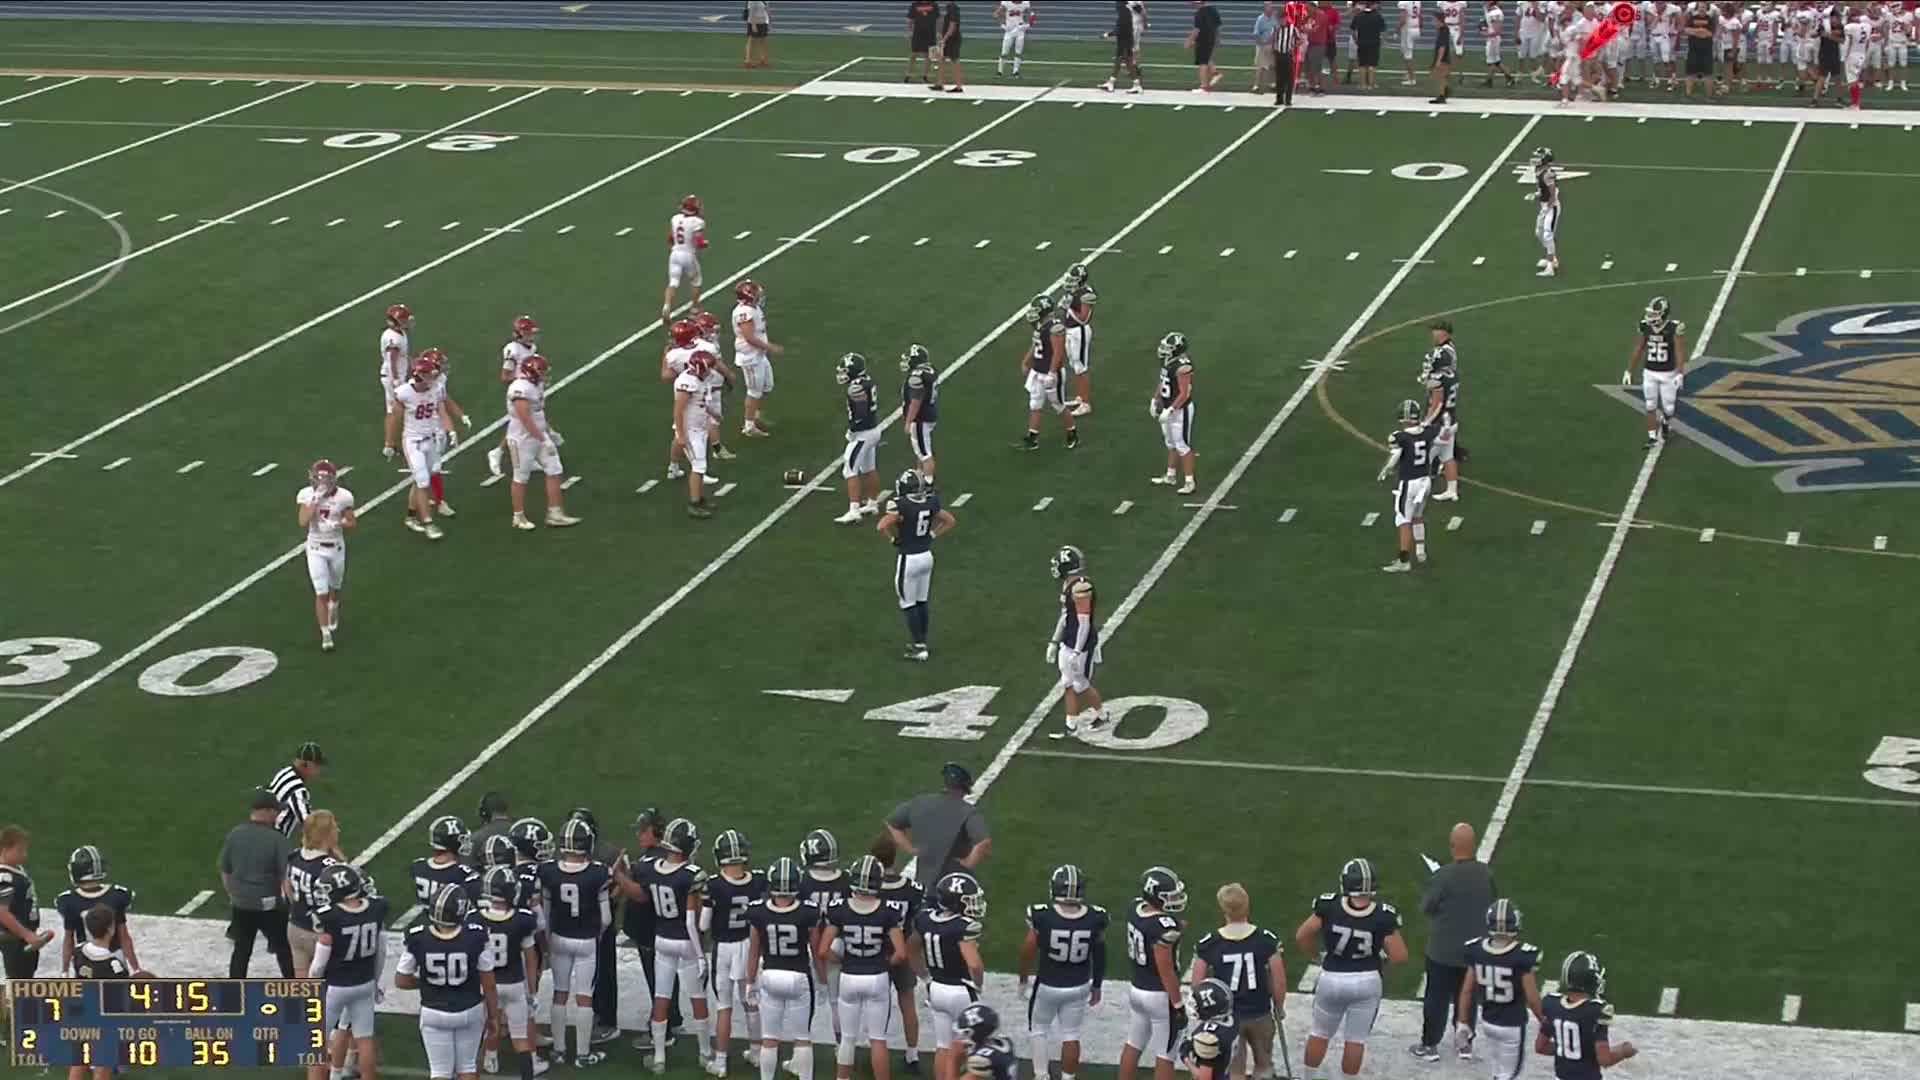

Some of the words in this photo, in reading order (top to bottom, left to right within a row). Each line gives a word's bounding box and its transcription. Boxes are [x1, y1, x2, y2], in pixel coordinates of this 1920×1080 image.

[1647, 341, 1669, 362] 26
[415, 402, 434, 420] 85
[1413, 440, 1427, 465] 5
[916, 509, 931, 537] 6
[1060, 549, 1072, 563] K
[444, 819, 461, 836] K
[524, 823, 541, 841] K
[807, 839, 820, 855] K
[333, 871, 351, 889] K
[948, 877, 965, 894] K
[560, 883, 579, 917] 9
[650, 883, 678, 918] 18
[341, 921, 377, 961] 70
[766, 923, 799, 956] 12
[843, 925, 883, 958] 25
[924, 931, 944, 969] 11
[1048, 929, 1091, 963] 56
[1332, 924, 1373, 960] 73
[425, 951, 468, 986] 50
[1222, 951, 1257, 992] 71
[1475, 963, 1514, 1004] 45
[1553, 1018, 1582, 1061] 10
